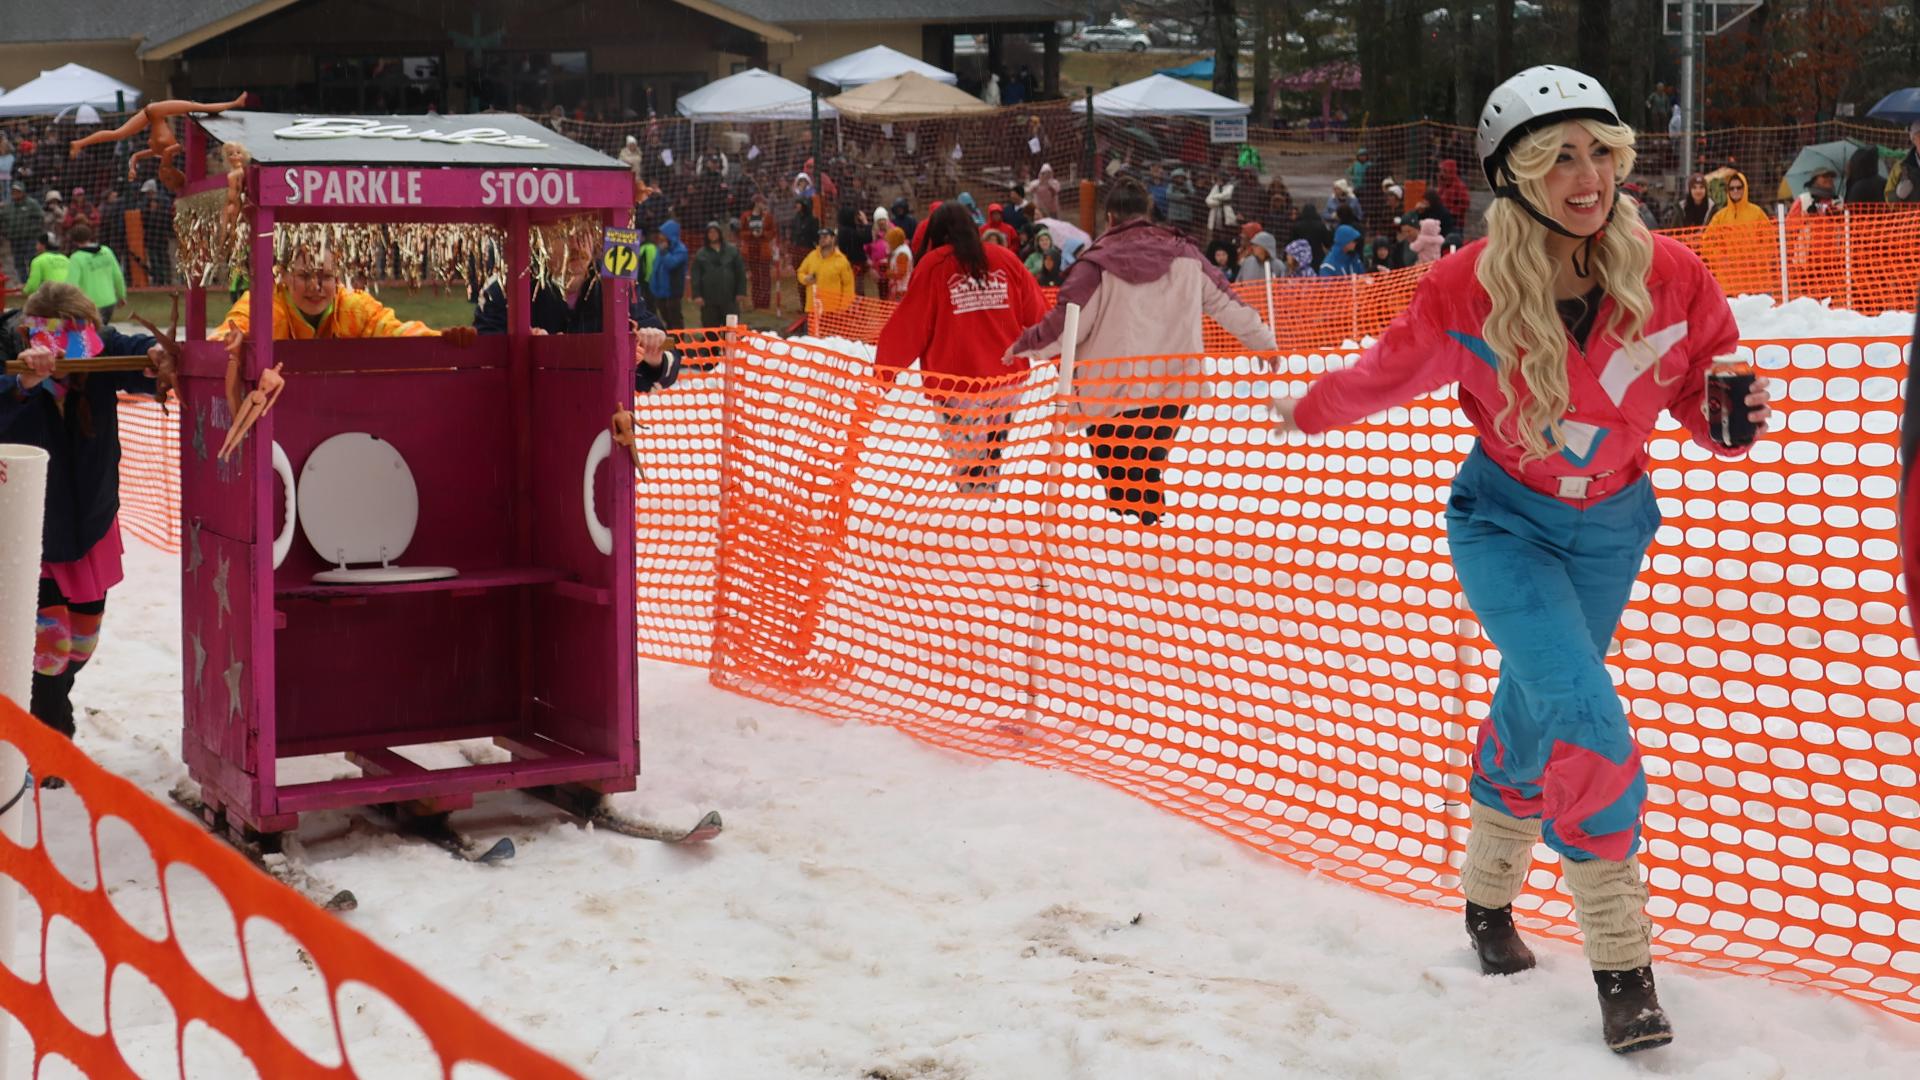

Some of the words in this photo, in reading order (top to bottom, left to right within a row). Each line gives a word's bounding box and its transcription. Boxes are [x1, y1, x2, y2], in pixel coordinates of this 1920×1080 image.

[285, 168, 422, 204] SPARKLE
[480, 170, 581, 205] STOOL
[609, 245, 632, 276] 12
